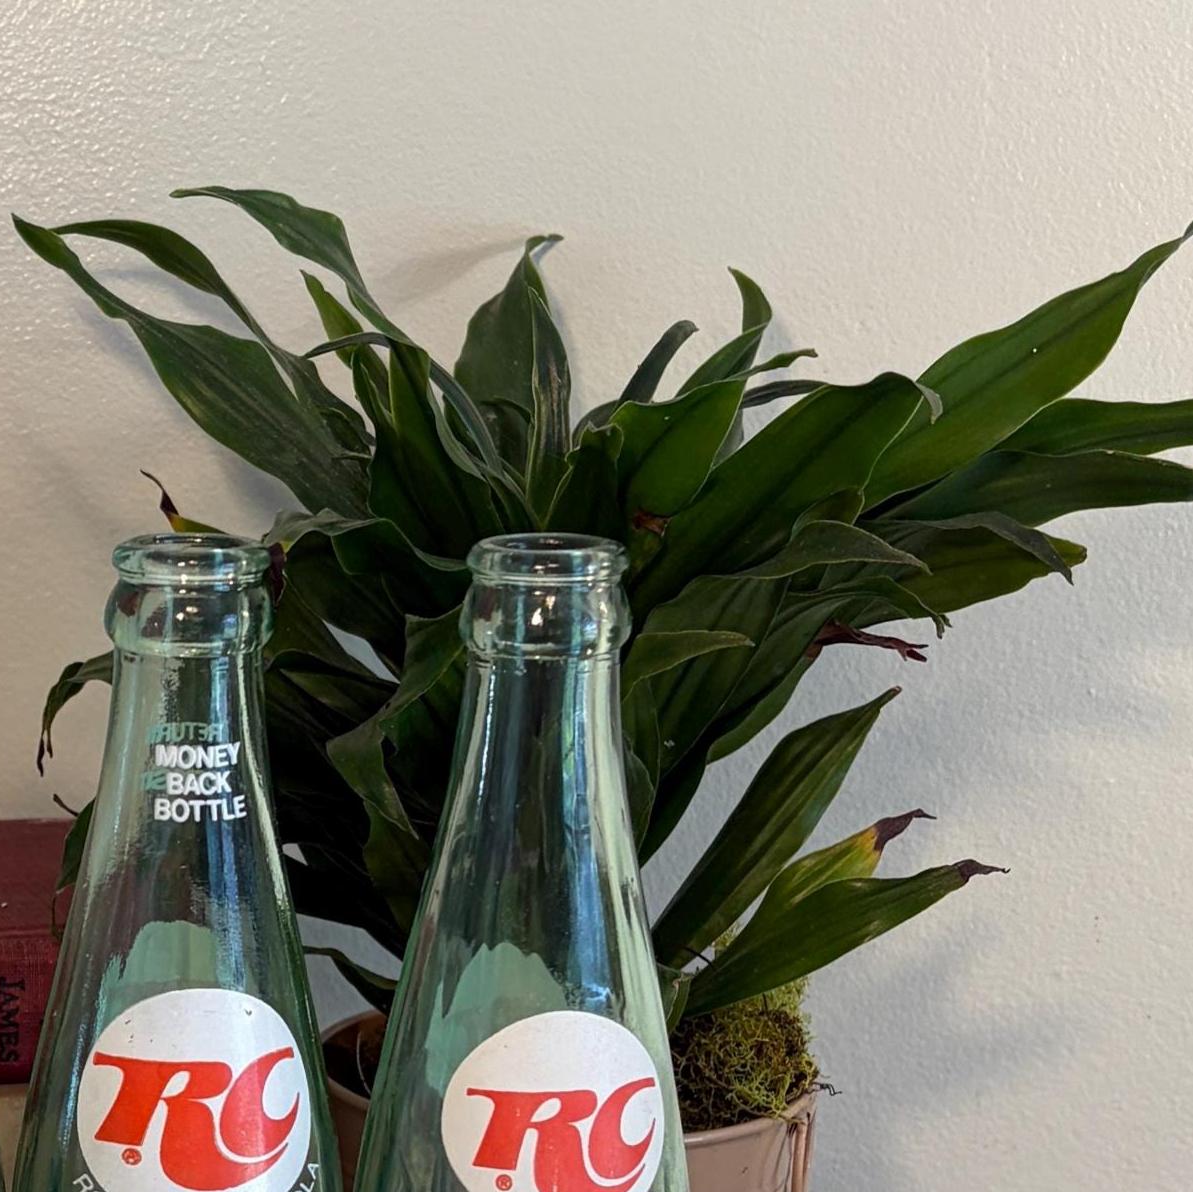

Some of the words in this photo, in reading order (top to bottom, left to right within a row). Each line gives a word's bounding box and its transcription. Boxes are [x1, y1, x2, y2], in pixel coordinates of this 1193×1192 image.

[155, 741, 241, 769] MONEY
[166, 771, 232, 796] BACK
[154, 795, 247, 823] BOTTLE
[0, 976, 26, 1063] JAMES
[93, 1046, 300, 1192] RC
